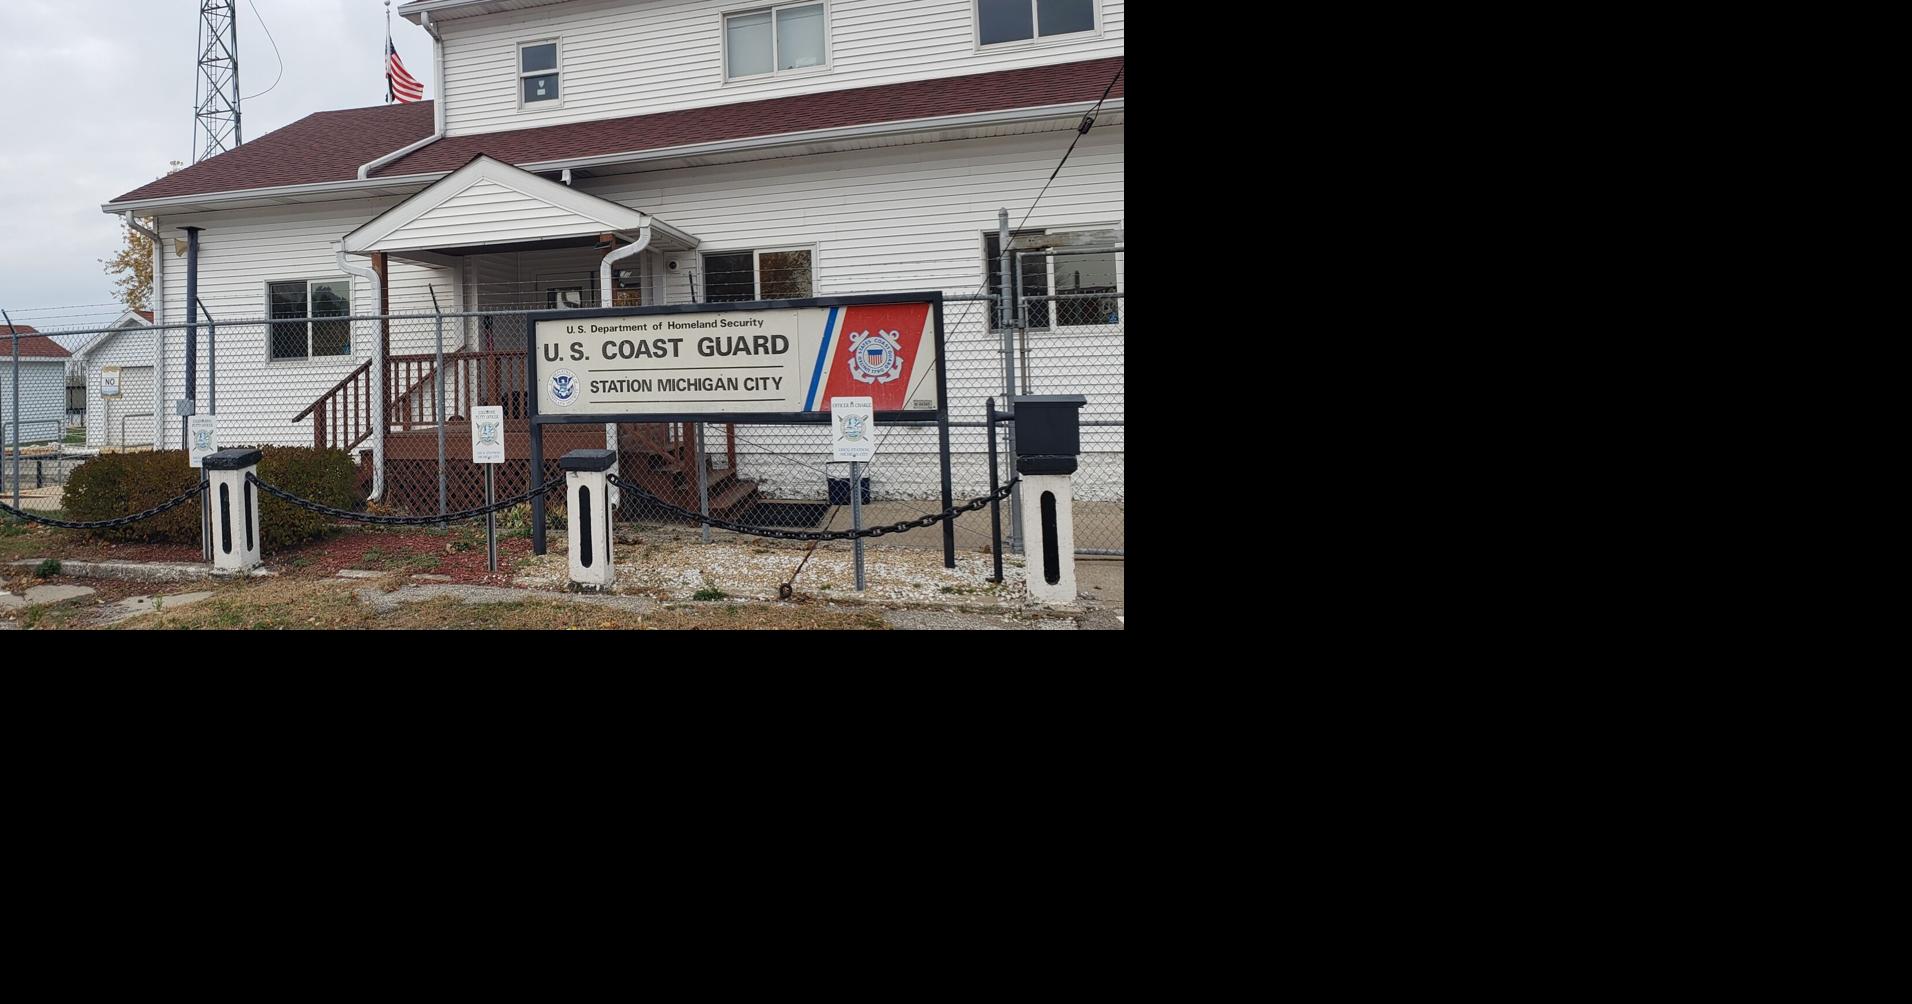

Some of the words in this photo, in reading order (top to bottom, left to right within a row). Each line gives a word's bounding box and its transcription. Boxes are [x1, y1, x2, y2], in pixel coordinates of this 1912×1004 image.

[591, 323, 647, 334] Department
[652, 322, 662, 331] of
[667, 319, 718, 330] Homeland
[720, 317, 764, 328] Security
[601, 338, 684, 360] COAST
[697, 334, 790, 357] GUARD
[590, 378, 653, 393] STATION
[658, 377, 739, 393] MICHIGAN
[743, 376, 783, 392] CITY
